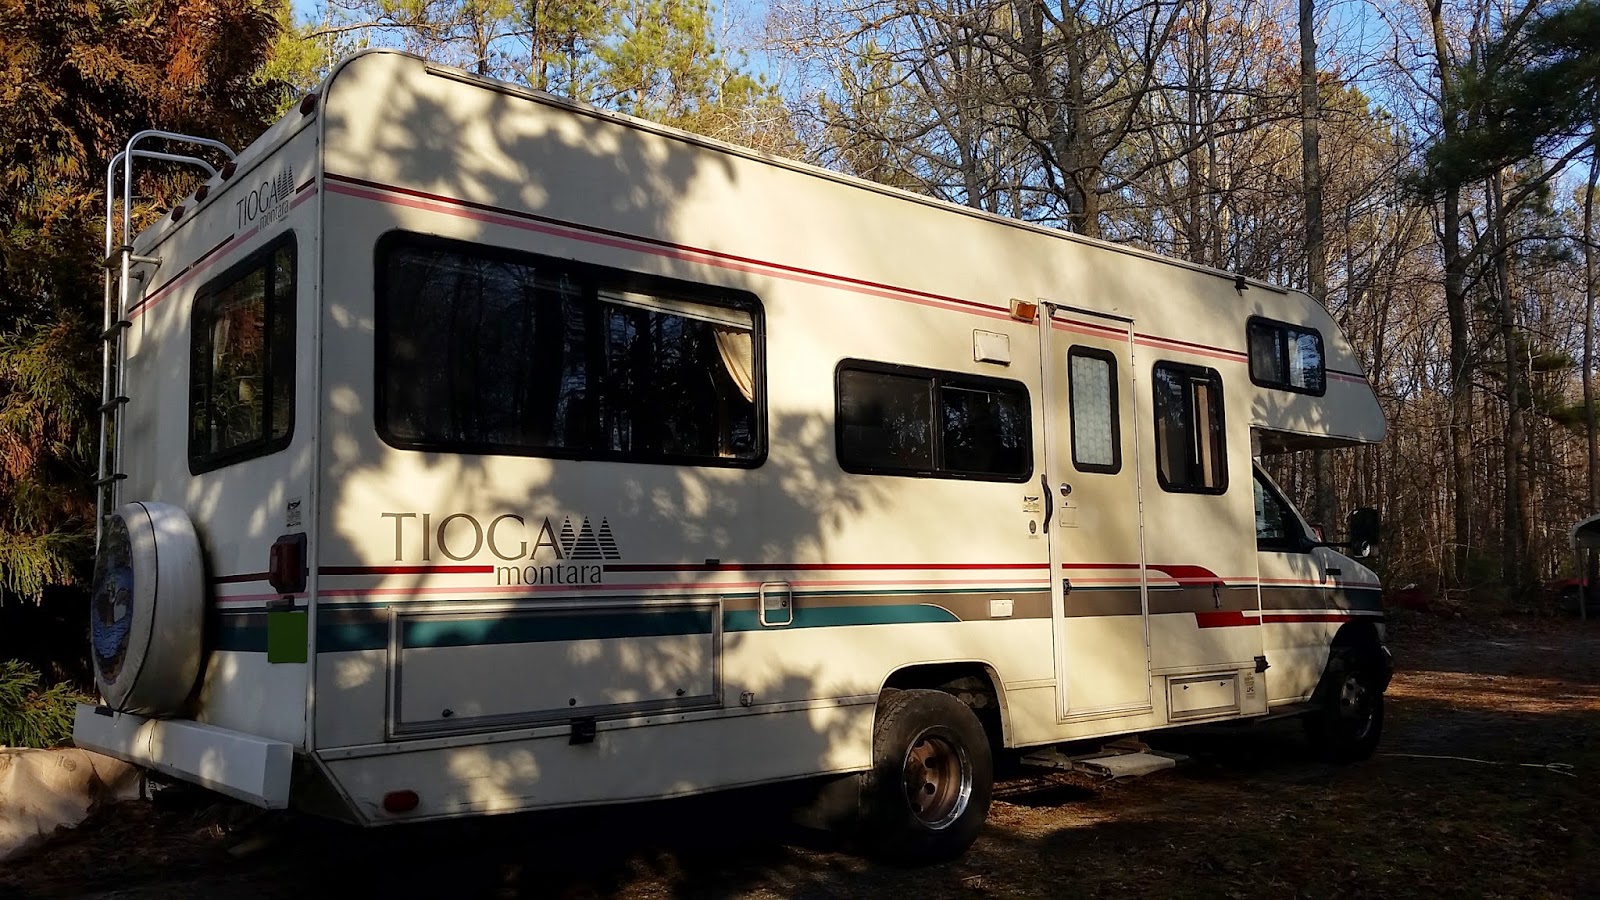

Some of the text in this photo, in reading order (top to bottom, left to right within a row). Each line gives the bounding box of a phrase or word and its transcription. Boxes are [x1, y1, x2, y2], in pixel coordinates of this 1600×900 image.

[236, 176, 278, 229] TIOGA
[259, 200, 289, 230] montara
[381, 512, 564, 562] TIOGA
[496, 563, 602, 586] montara
